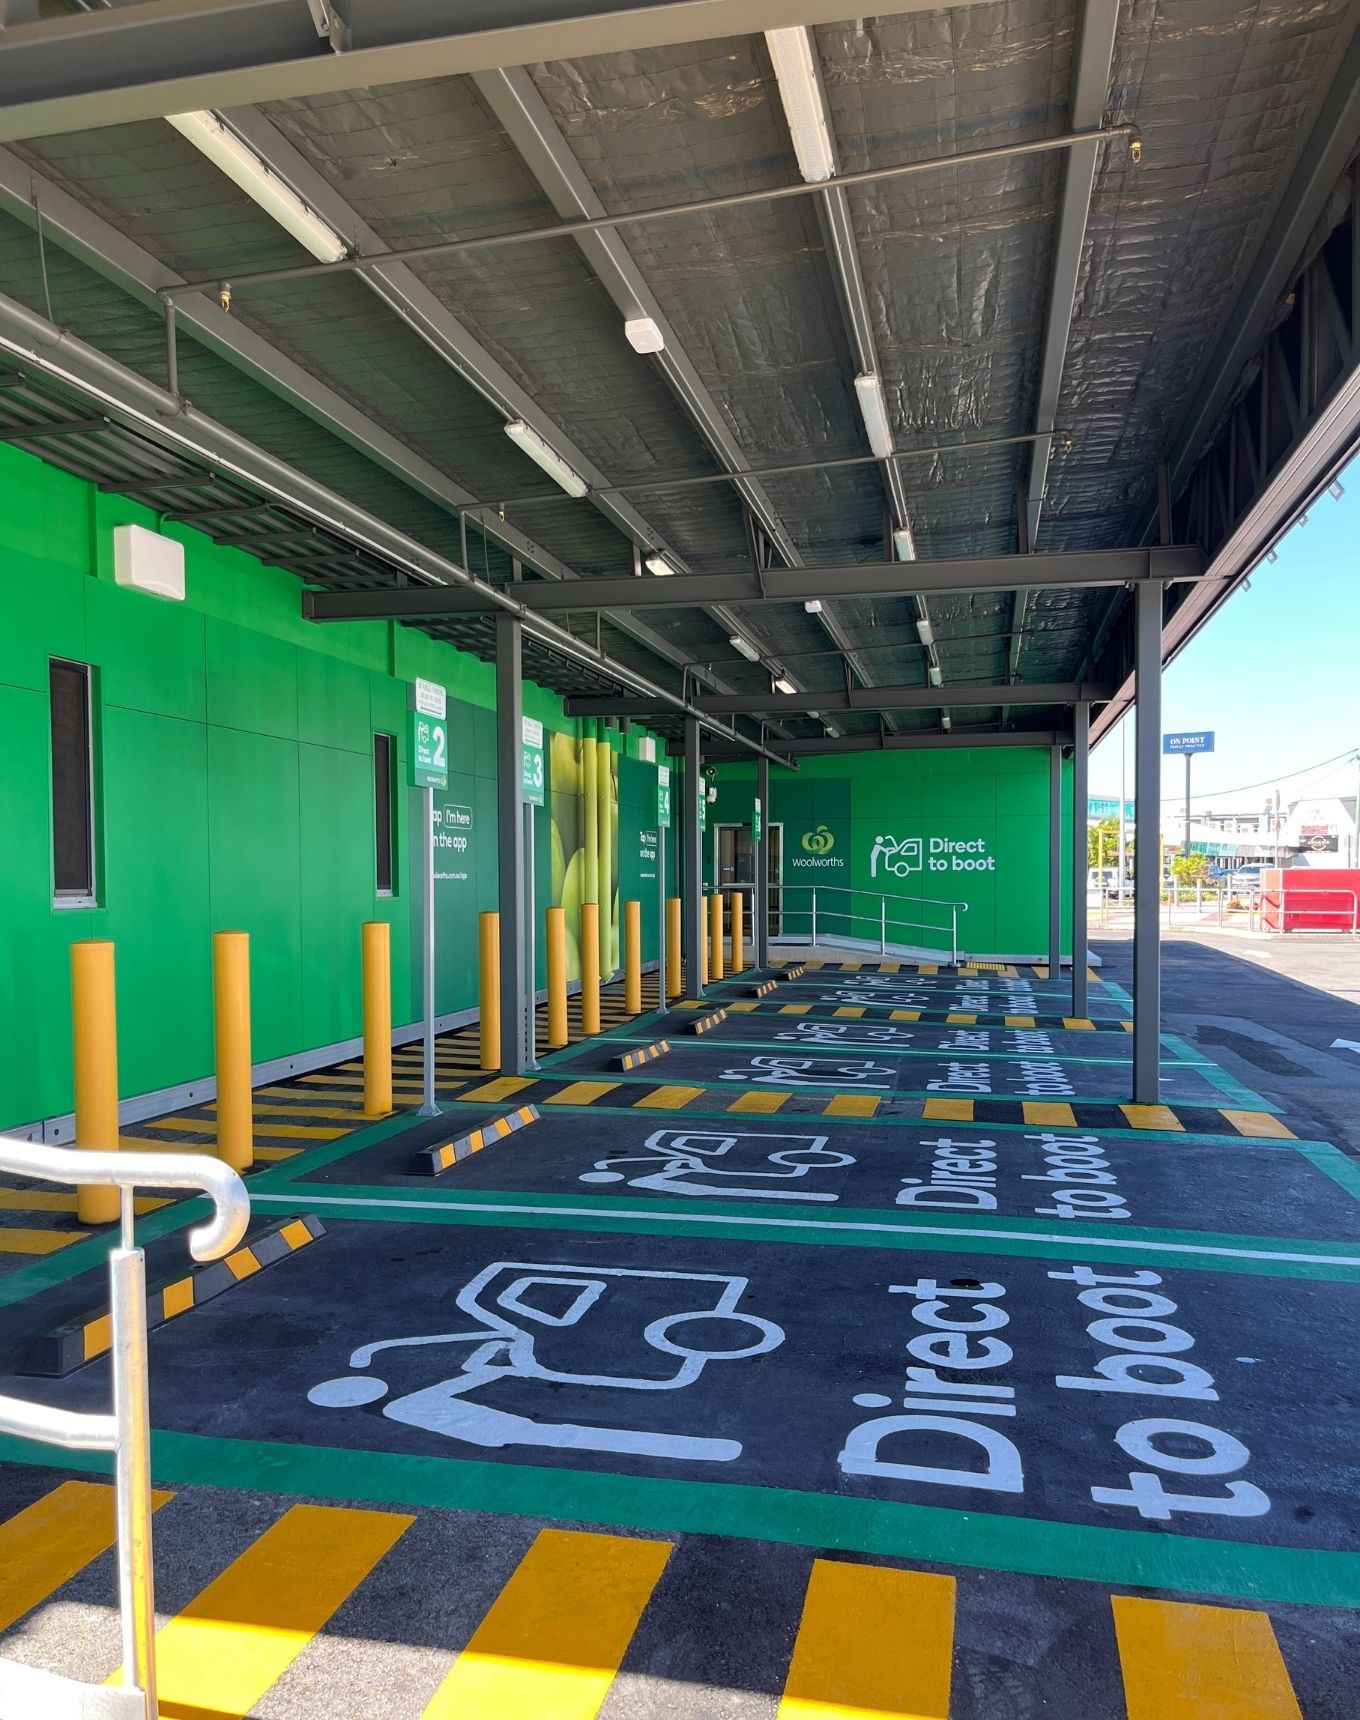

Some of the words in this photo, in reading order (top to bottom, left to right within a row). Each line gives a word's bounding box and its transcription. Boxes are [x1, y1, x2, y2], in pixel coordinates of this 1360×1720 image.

[432, 726, 445, 767] 2
[1182, 736, 1205, 745] POINT
[533, 754, 543, 788] 3
[433, 810, 442, 826] ap
[456, 810, 470, 824] here
[664, 791, 669, 814] 4
[439, 832, 452, 848] the
[453, 836, 467, 852] app
[929, 838, 985, 853] Direct
[928, 857, 948, 871] to
[952, 856, 995, 871] boot
[895, 1138, 998, 1210] Direct
[1021, 1133, 1117, 1185] boot
[1034, 1189, 1132, 1218] to
[1047, 1266, 1219, 1401] boot
[837, 1278, 1024, 1493] Direct
[1091, 1417, 1271, 1520] to
